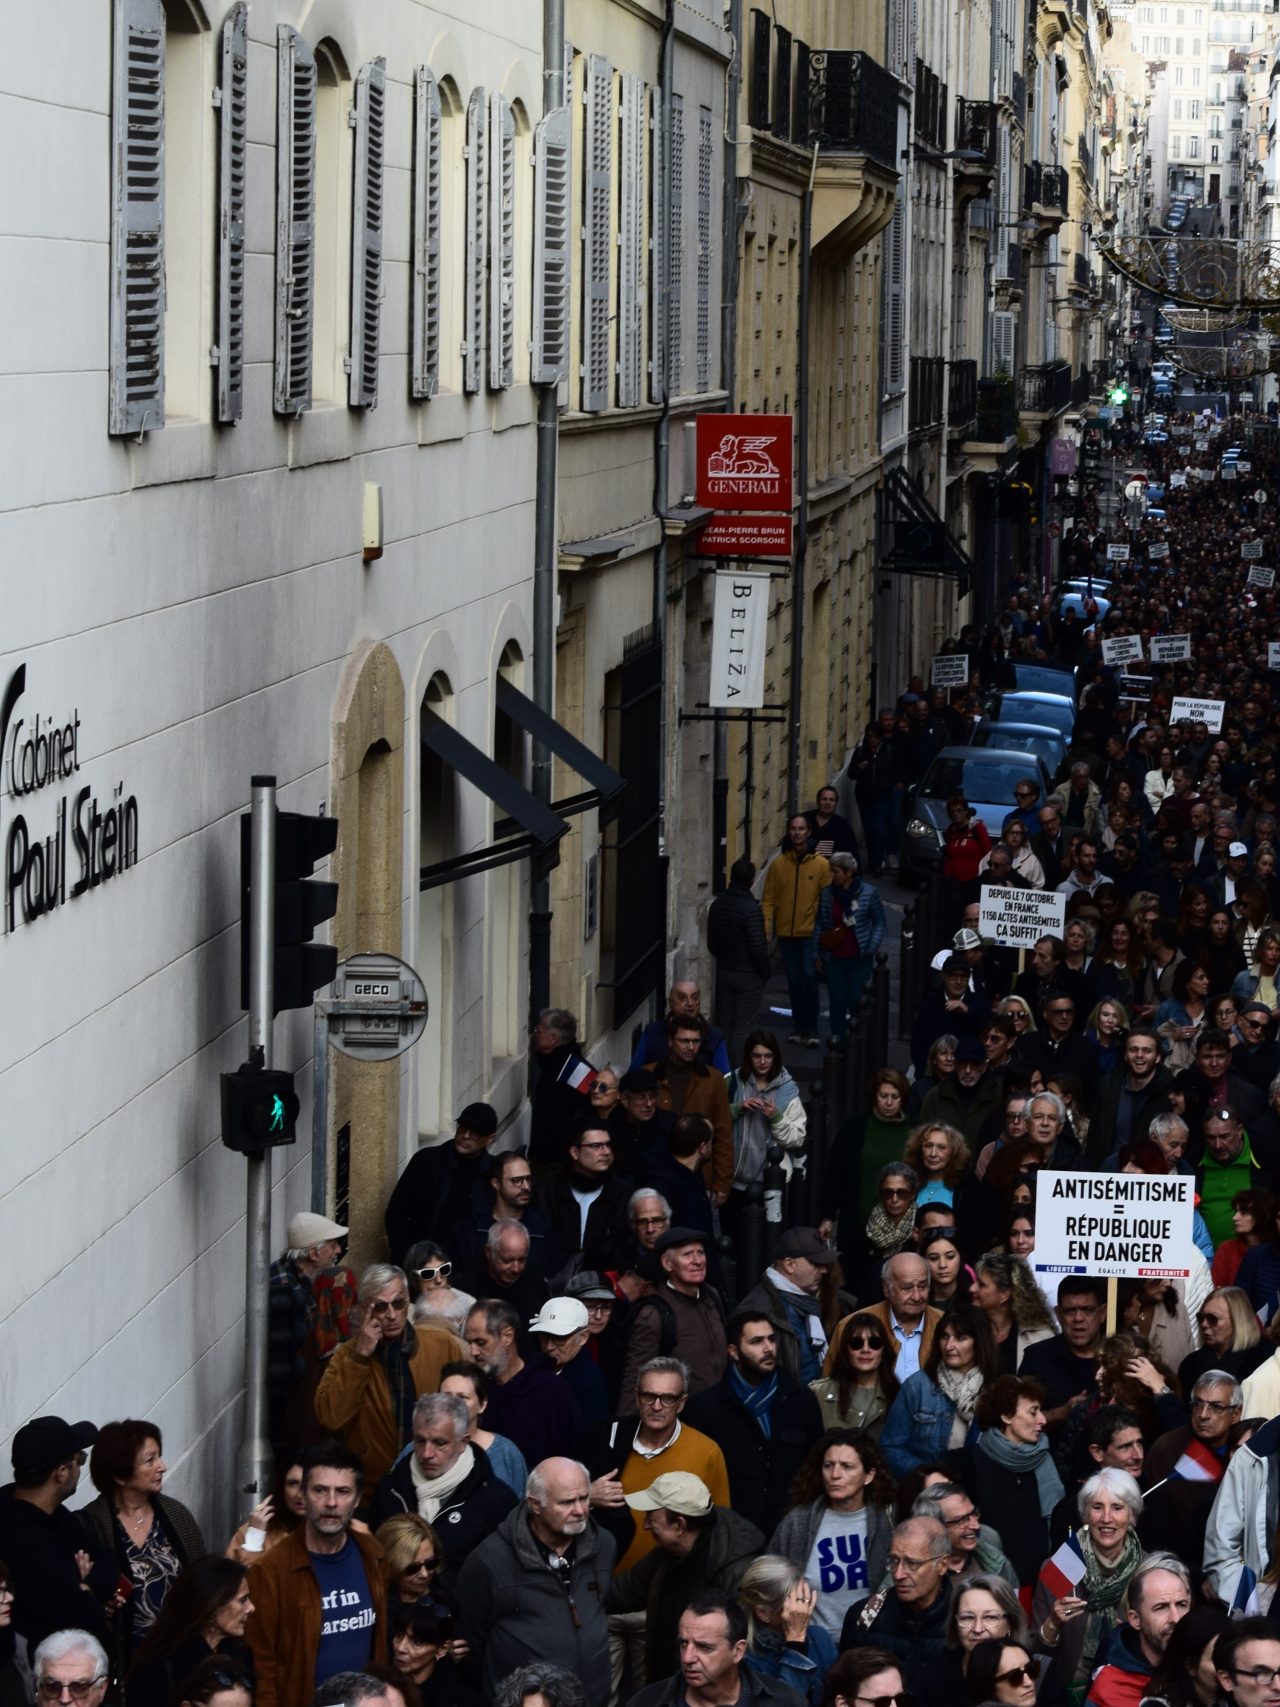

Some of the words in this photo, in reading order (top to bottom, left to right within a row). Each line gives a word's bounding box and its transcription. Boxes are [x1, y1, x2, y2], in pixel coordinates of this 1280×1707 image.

[708, 480, 779, 494] GENERALI
[704, 526, 759, 535] JEAN-PIERRE
[761, 527, 785, 535] BRUN
[702, 536, 737, 544] PATRICK
[739, 537, 786, 545] SCORSONE
[1190, 710, 1204, 718] NON
[11, 708, 81, 797] Cabinet
[9, 796, 67, 933] Paul
[71, 780, 138, 898] Stein
[988, 888, 1011, 900] DEPUIS
[1012, 891, 1019, 901] LE
[1020, 891, 1025, 901] 7
[1025, 892, 1056, 906] OCTOBRE,
[1004, 901, 1013, 911] EN
[1014, 903, 1039, 914] FRANCE
[982, 910, 996, 921] 1150
[997, 912, 1018, 923] ACTES
[1019, 914, 1060, 928] ANTISÉMITES
[996, 924, 1008, 938] ÇA
[1009, 925, 1038, 940] SUFFIT
[1052, 1178, 1187, 1202] ANTISÉMITISME
[1066, 1214, 1171, 1239] RÉPUBLIQUE
[1068, 1241, 1089, 1260] EN
[1095, 1242, 1162, 1263] DANGER
[1046, 1265, 1076, 1273] LIBERTÉ
[1098, 1267, 1126, 1275] ÉGALITÉ
[1142, 1268, 1185, 1277] FRATERNITÉ
[817, 1533, 868, 1568] SU
[340, 1589, 361, 1607] in
[321, 1608, 376, 1635] arseill
